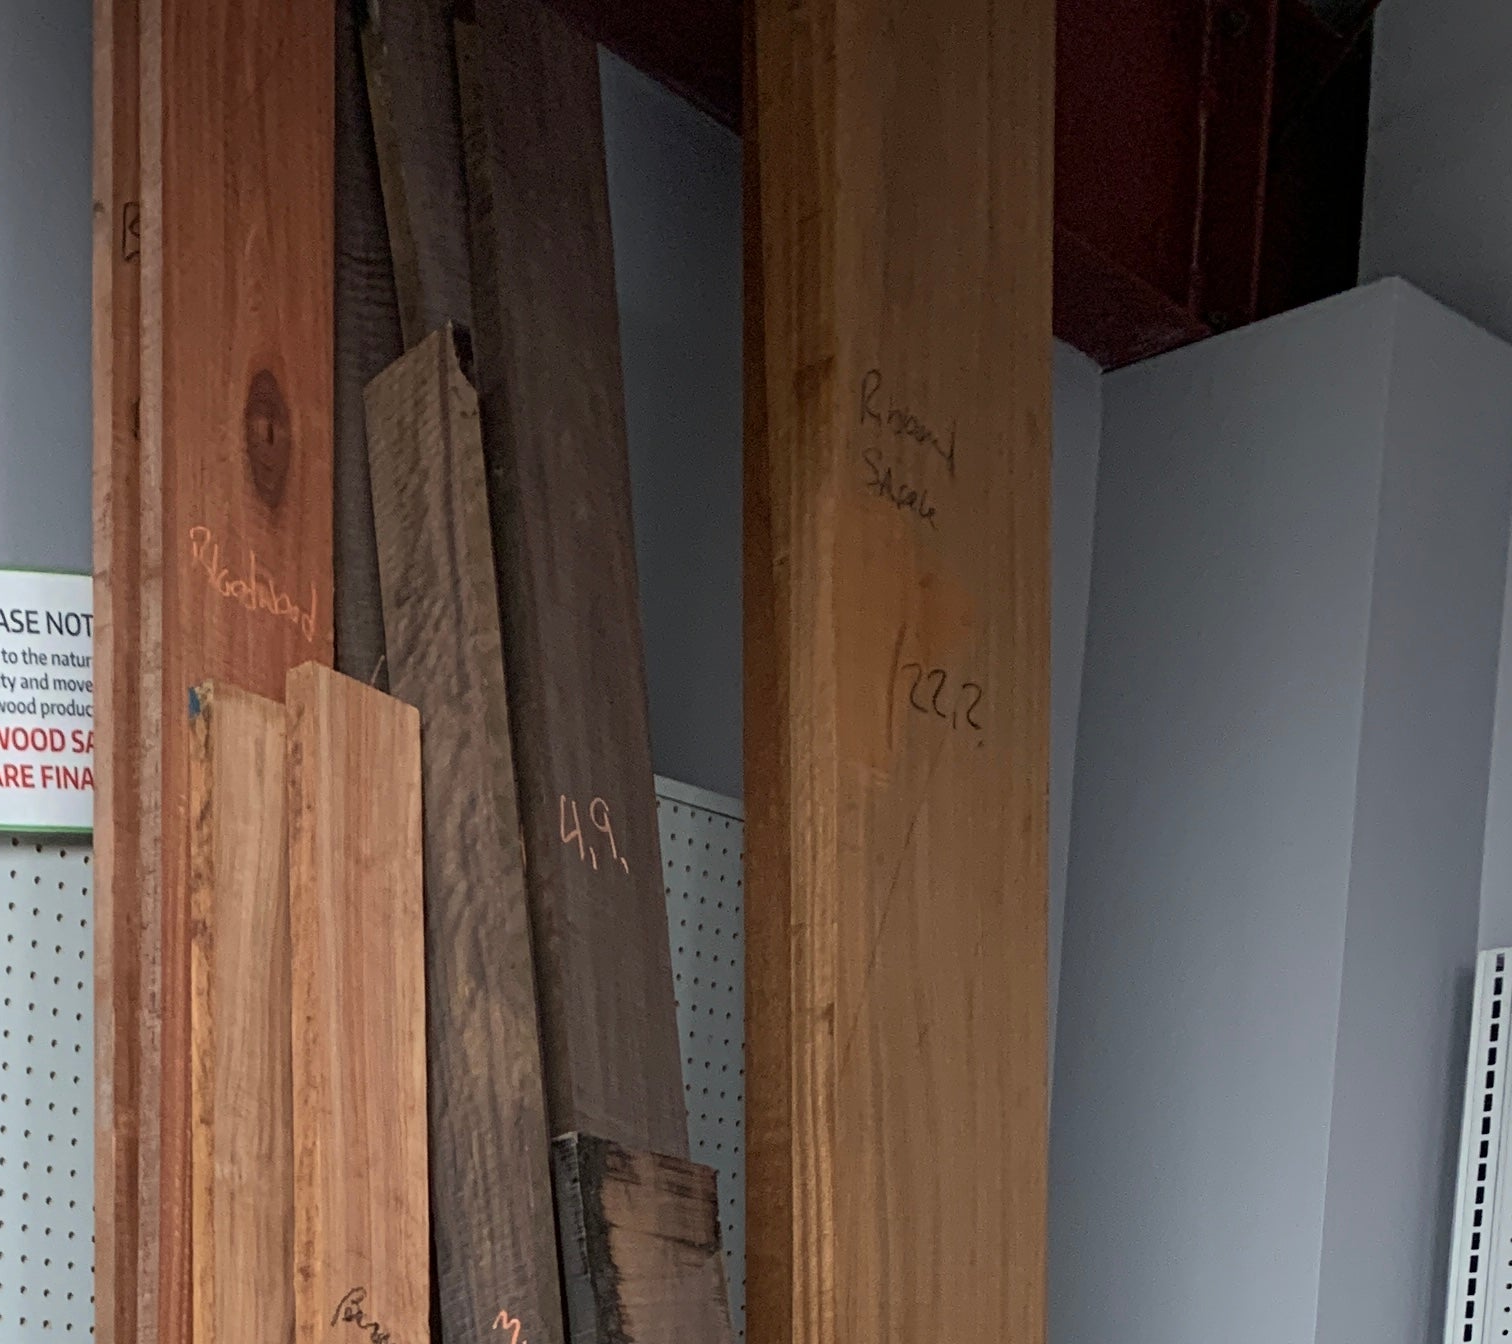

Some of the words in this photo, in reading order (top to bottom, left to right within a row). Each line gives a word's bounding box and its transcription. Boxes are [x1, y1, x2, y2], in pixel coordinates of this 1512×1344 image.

[46, 611, 93, 638] NOT
[2, 648, 18, 665] to
[22, 647, 48, 667] the
[20, 673, 49, 691] and
[53, 677, 93, 694] move
